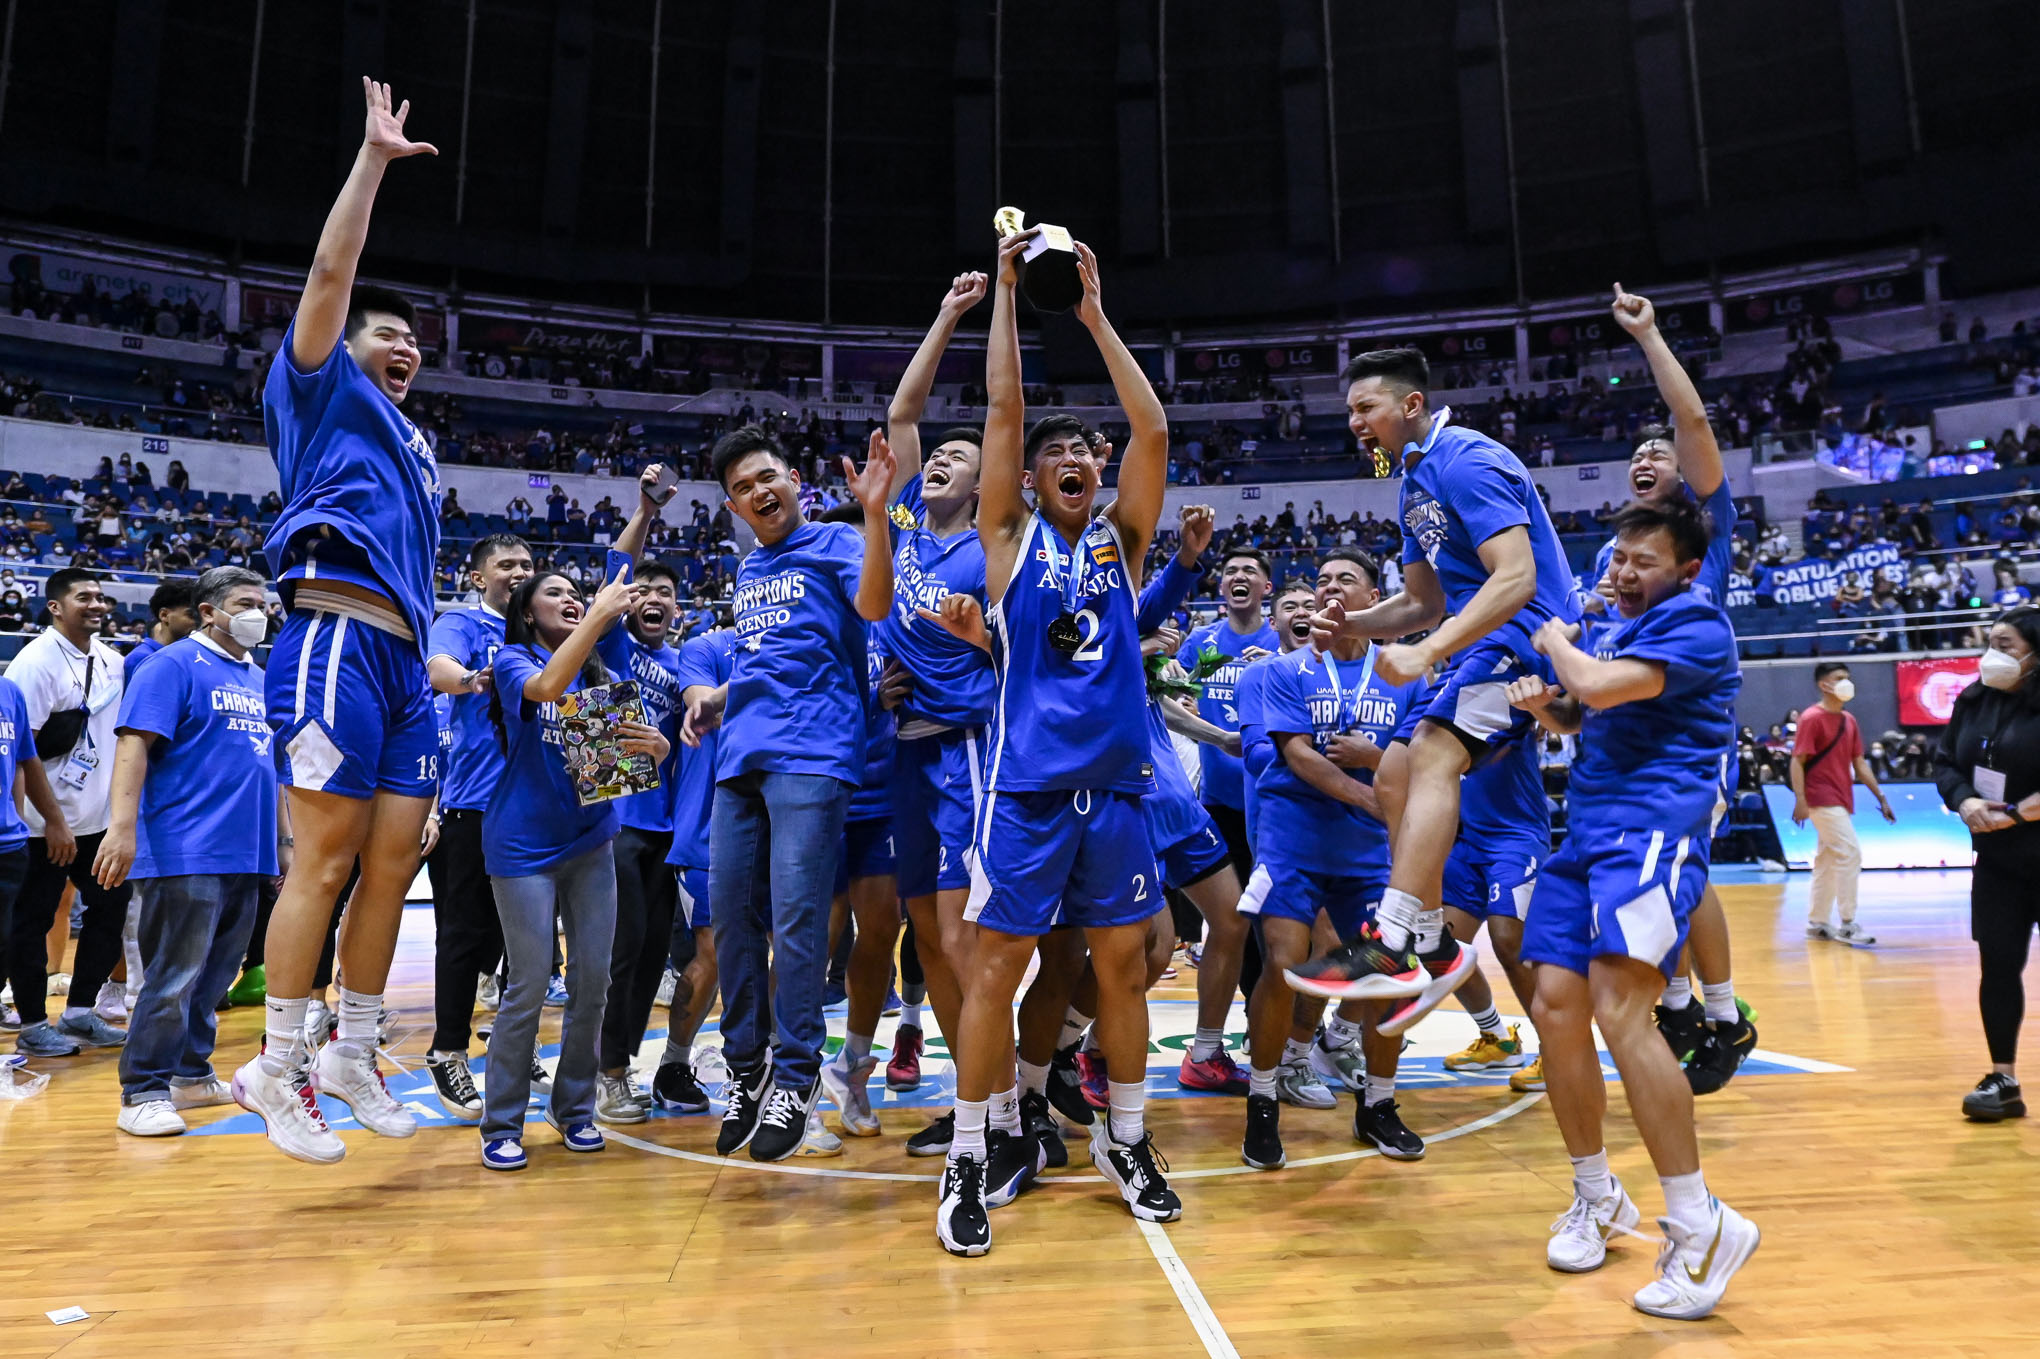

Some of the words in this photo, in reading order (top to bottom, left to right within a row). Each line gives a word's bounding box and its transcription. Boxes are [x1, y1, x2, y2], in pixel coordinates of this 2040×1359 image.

[1865, 283, 1892, 299] LG
[1575, 325, 1600, 340] LG
[1464, 337, 1486, 351] LG
[1218, 353, 1241, 368] LG
[1290, 350, 1312, 364] LG
[143, 440, 168, 452] 215
[528, 475, 549, 486] 216
[1242, 489, 1260, 498] 218
[1037, 567, 1120, 597] ATNEO
[1072, 608, 1103, 661] 2
[416, 754, 438, 780] 18
[886, 835, 897, 858] 1
[1132, 874, 1148, 902] 2
